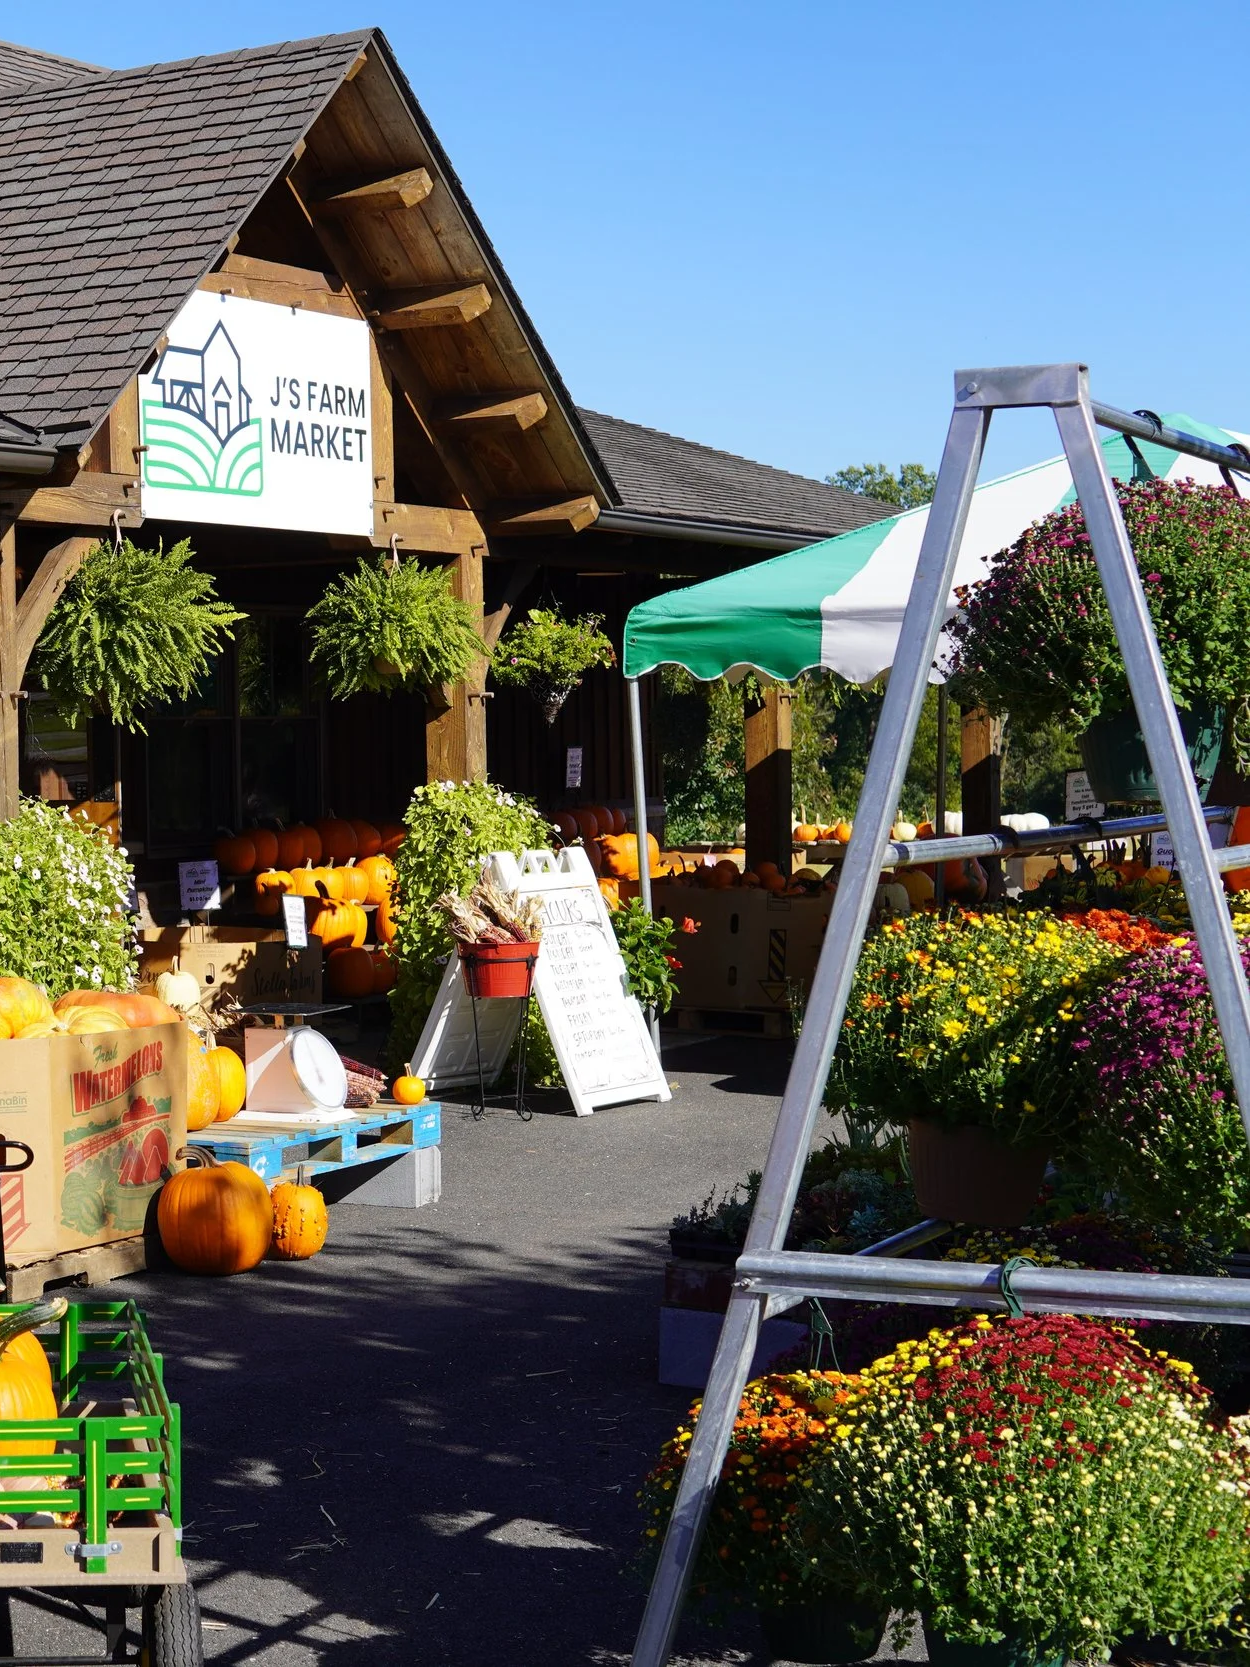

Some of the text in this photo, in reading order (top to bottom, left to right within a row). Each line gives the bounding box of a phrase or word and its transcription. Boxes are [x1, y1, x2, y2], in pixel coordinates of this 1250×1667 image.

[270, 376, 366, 419] J'S FARM
[271, 417, 368, 463] MARKET
[1086, 803, 1094, 811] get
[541, 898, 584, 925] HOURS
[567, 1011, 592, 1027] FRIDAY
[93, 1042, 118, 1068] Fresh
[73, 1041, 163, 1114] WATERMELONS
